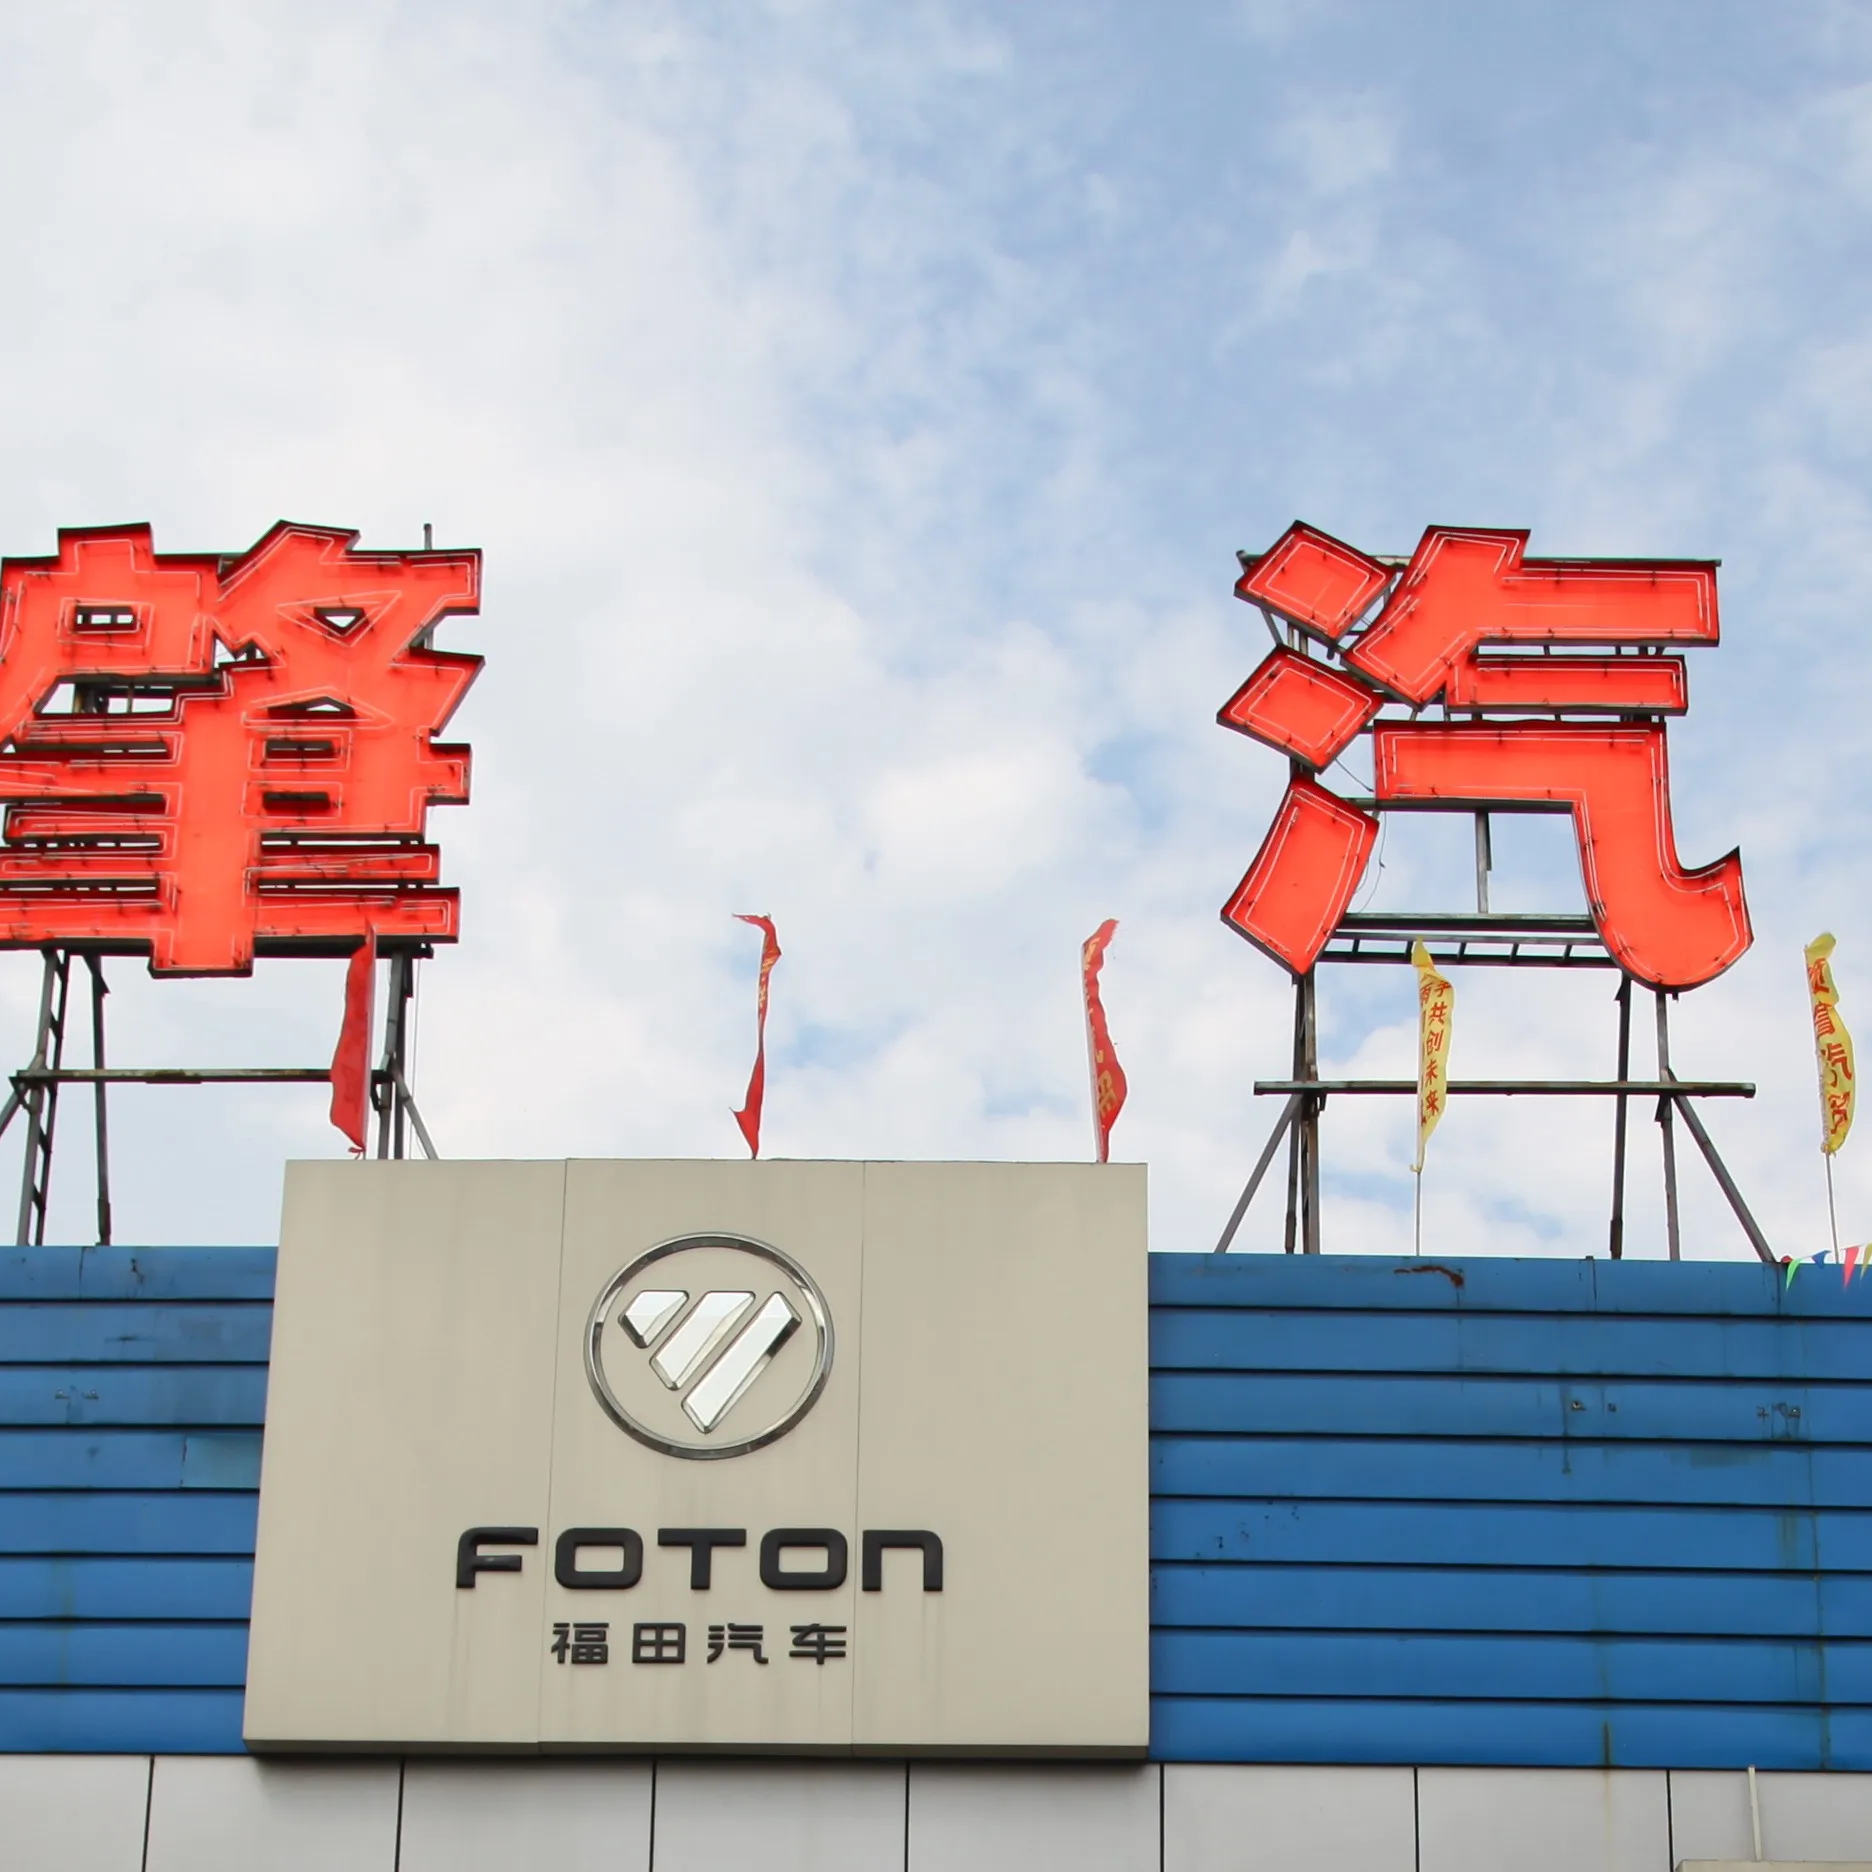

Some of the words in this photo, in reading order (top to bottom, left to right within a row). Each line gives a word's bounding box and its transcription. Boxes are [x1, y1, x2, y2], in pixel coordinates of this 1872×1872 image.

[456, 1527, 944, 1592] FOTON
[551, 1622, 848, 1665] 福田汽车
